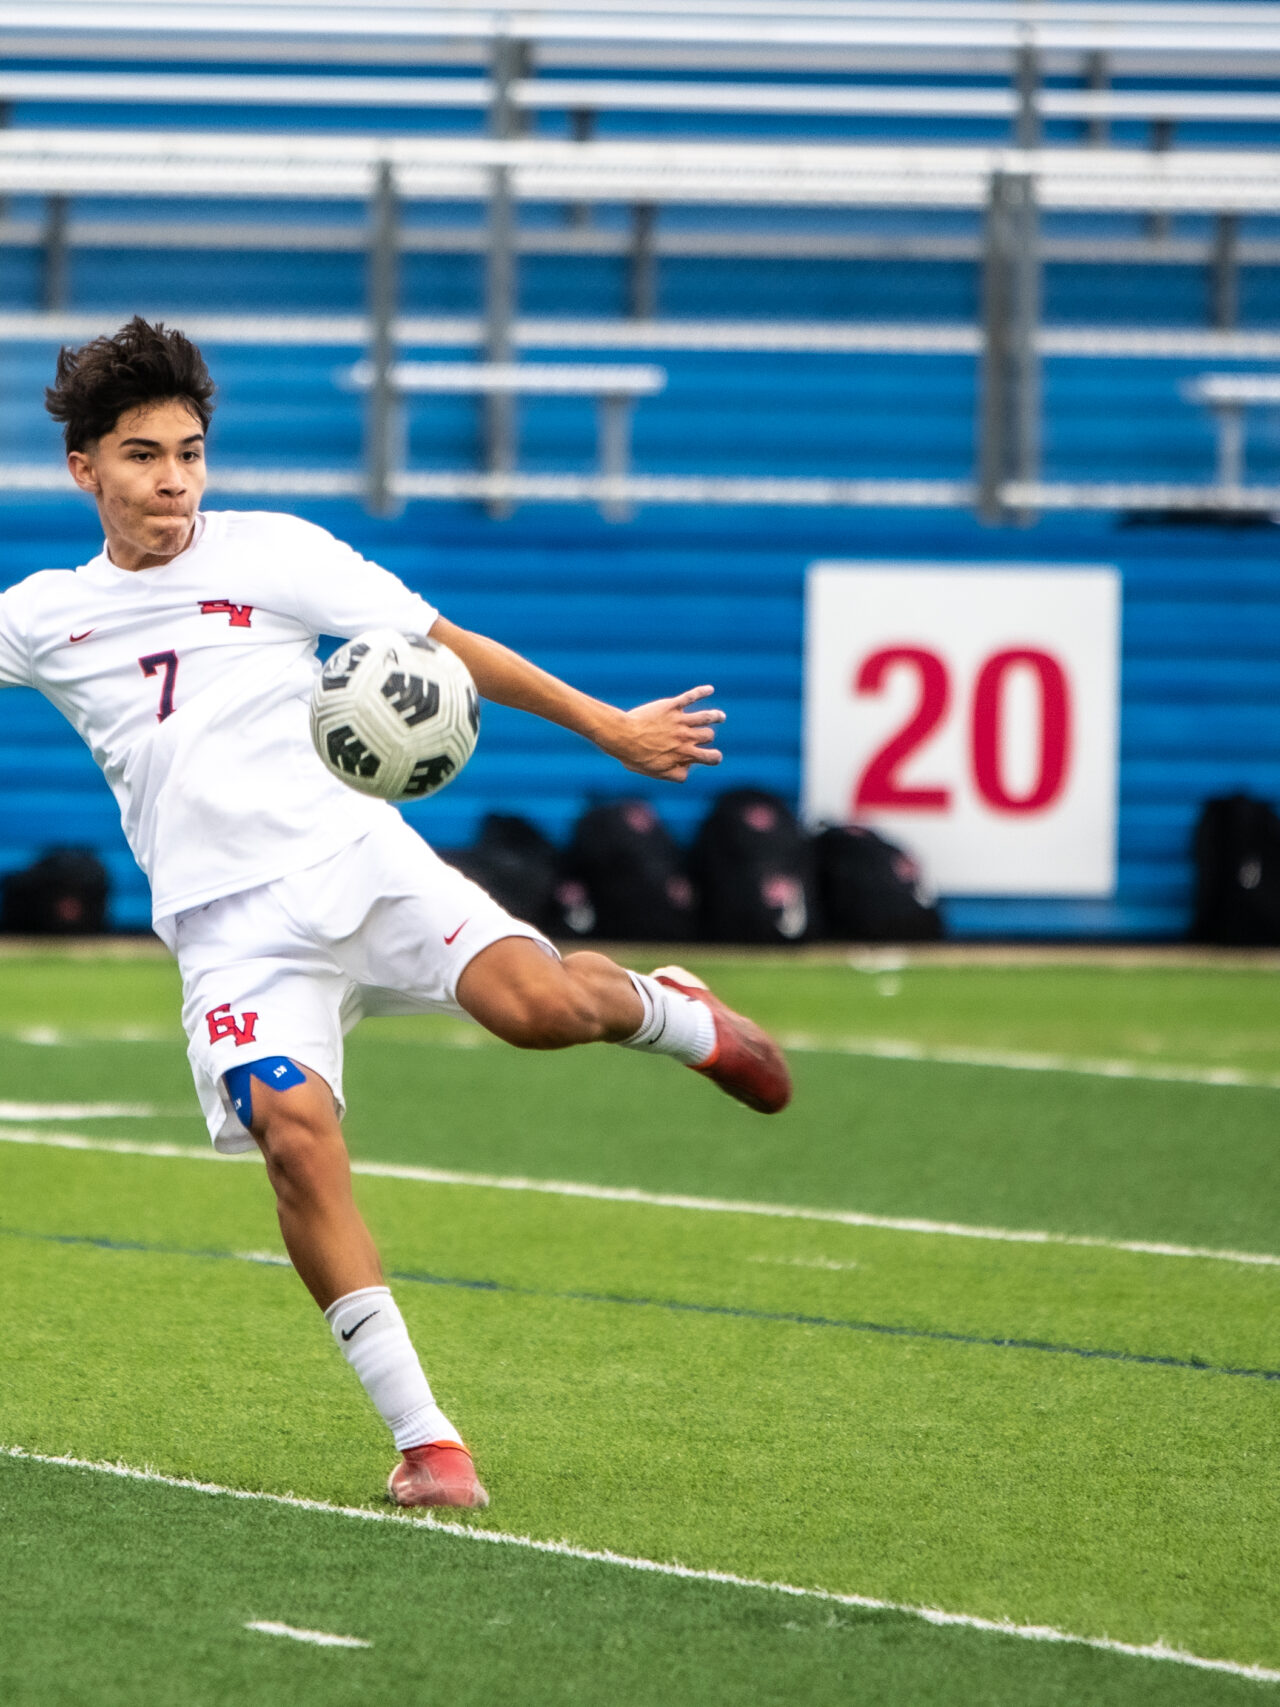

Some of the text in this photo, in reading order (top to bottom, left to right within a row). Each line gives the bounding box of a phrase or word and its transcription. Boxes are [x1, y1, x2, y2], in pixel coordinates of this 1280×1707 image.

[138, 648, 179, 725] 7
[851, 644, 1073, 819] 20
[205, 1003, 259, 1047] EV
